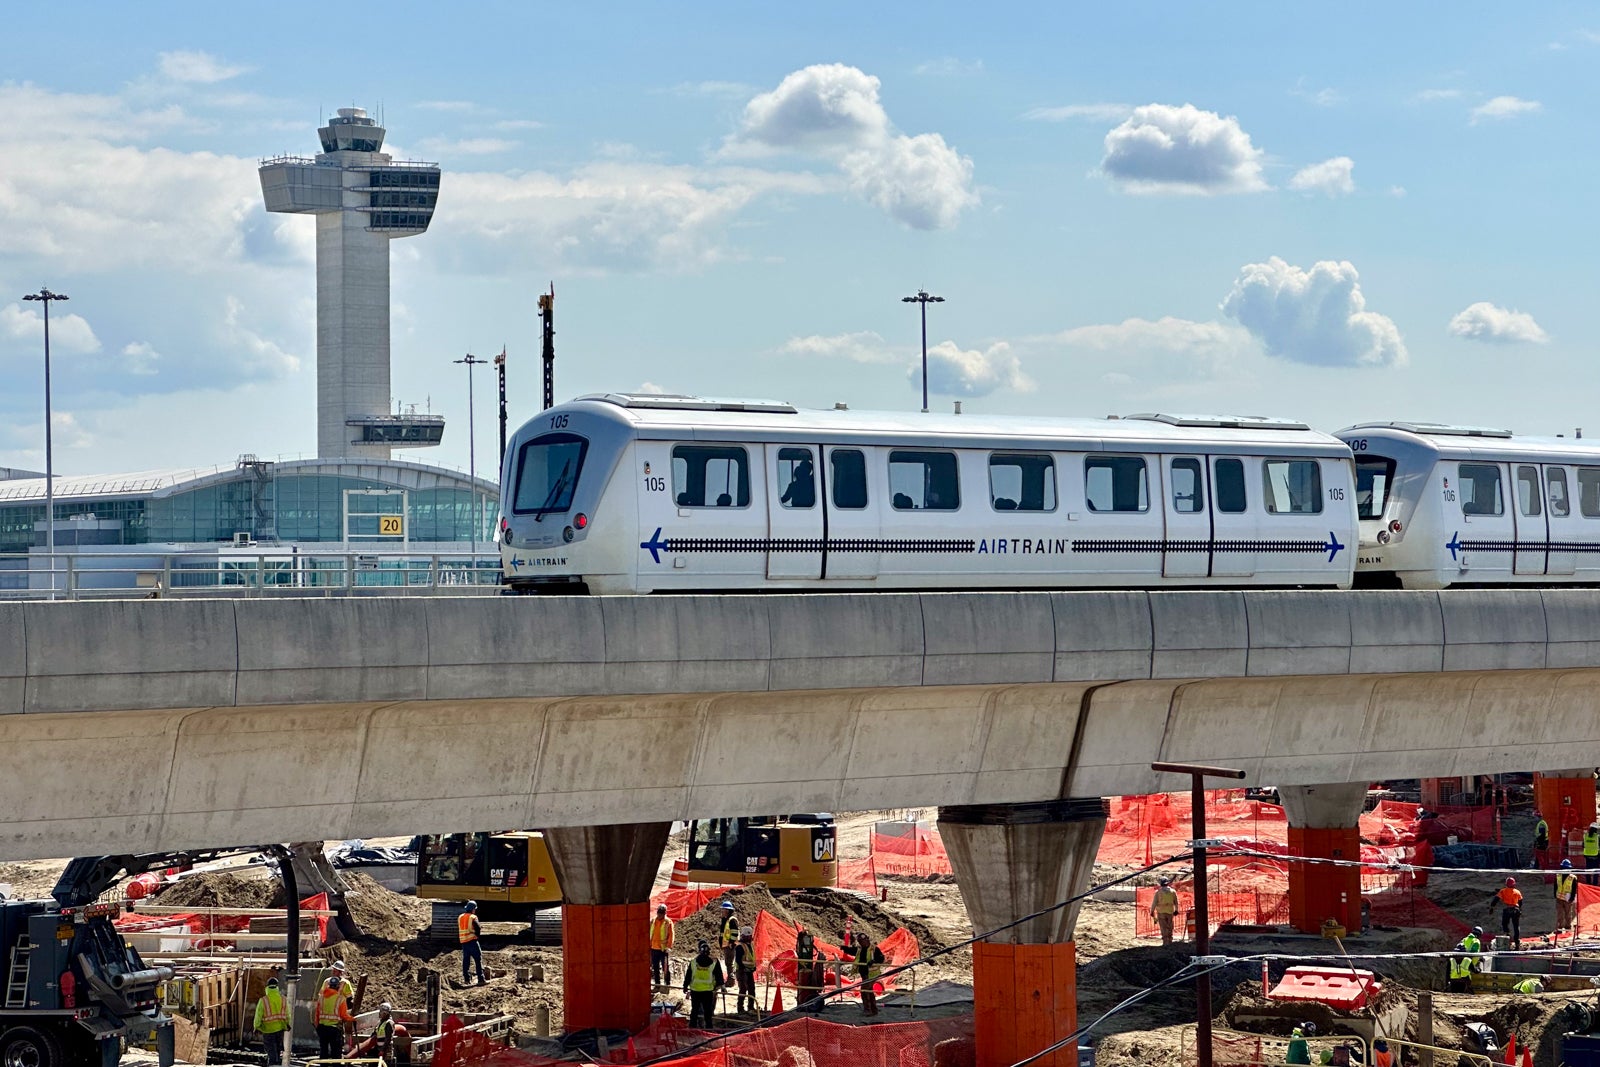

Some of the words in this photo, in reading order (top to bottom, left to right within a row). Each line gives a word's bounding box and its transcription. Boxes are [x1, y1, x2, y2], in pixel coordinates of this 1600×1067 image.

[550, 415, 569, 429] 105
[644, 477, 665, 491] 105
[1328, 488, 1344, 501] 105
[1442, 489, 1456, 502] 106
[383, 519, 399, 531] 20
[977, 538, 1066, 554] AIRTRAIN
[528, 557, 567, 566] AIRTRAIN
[1357, 556, 1382, 564] RAIN
[814, 837, 835, 860] CAT
[746, 856, 759, 866] CAT
[490, 868, 505, 879] CAT
